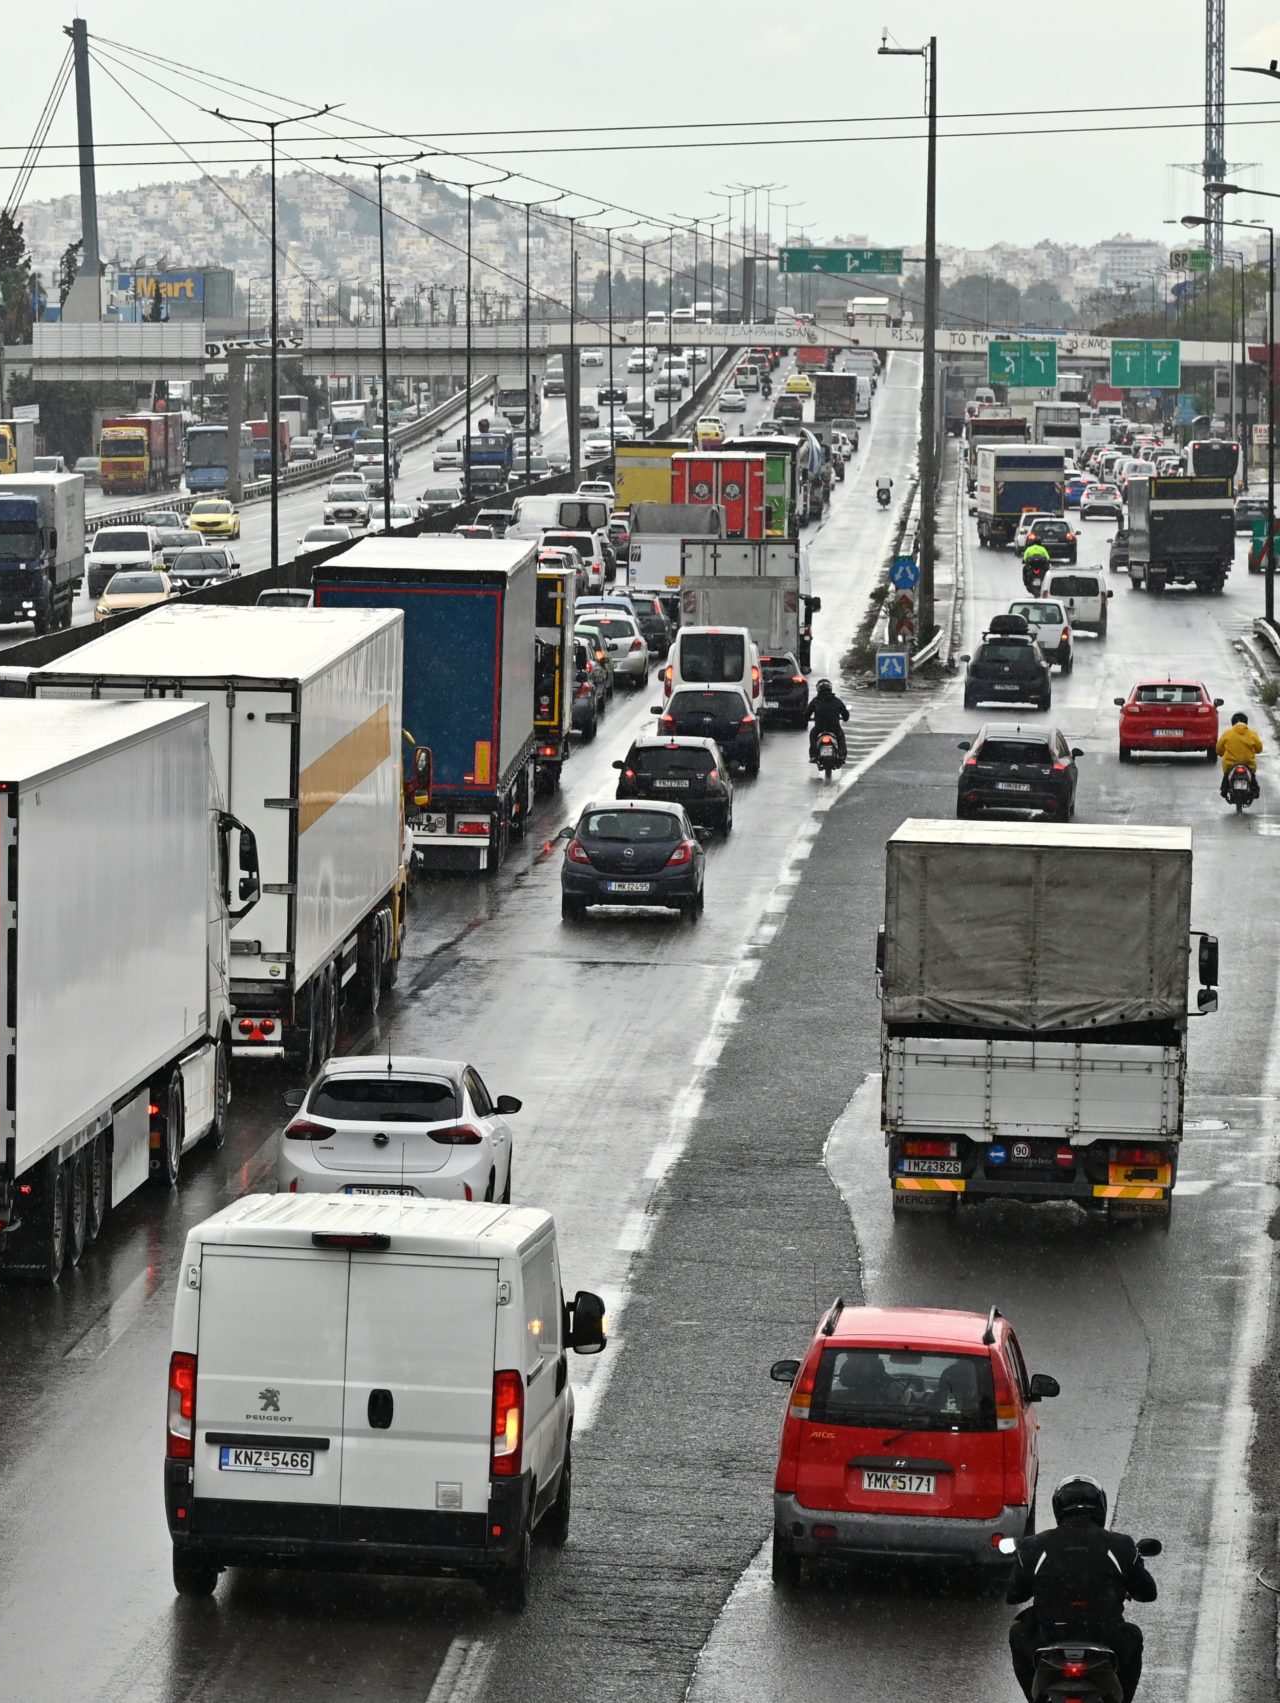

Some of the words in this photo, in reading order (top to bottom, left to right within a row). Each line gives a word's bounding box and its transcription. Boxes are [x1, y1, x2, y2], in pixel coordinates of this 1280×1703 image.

[136, 277, 193, 298] Mart
[1016, 1146, 1028, 1156] 90
[245, 1414, 294, 1423] PEUGEOT
